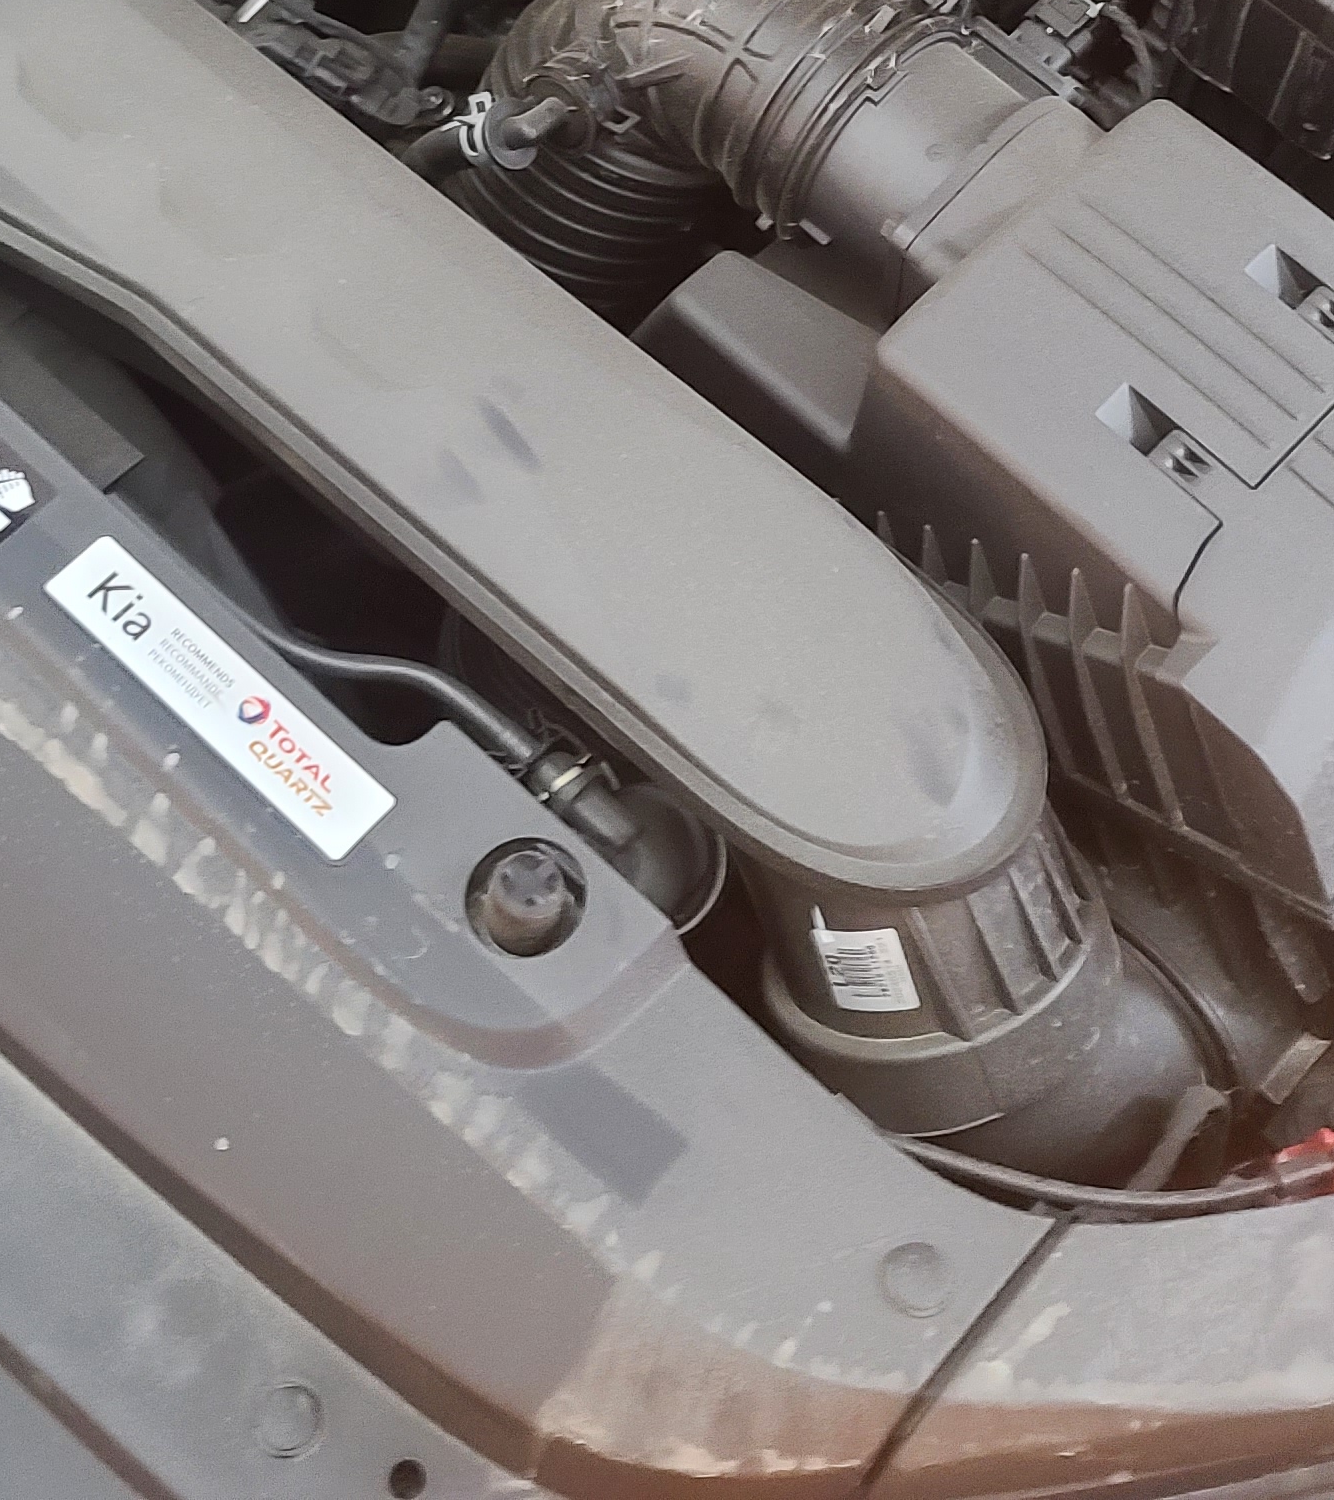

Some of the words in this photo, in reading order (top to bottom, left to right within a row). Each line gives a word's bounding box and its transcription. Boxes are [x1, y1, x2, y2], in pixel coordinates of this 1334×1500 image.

[86, 572, 152, 641] Kia
[158, 637, 224, 700] RECOMMANDE
[170, 626, 236, 689] RECOMMENDS
[248, 739, 334, 817] QUARTZ
[267, 719, 332, 794] TOTAL
